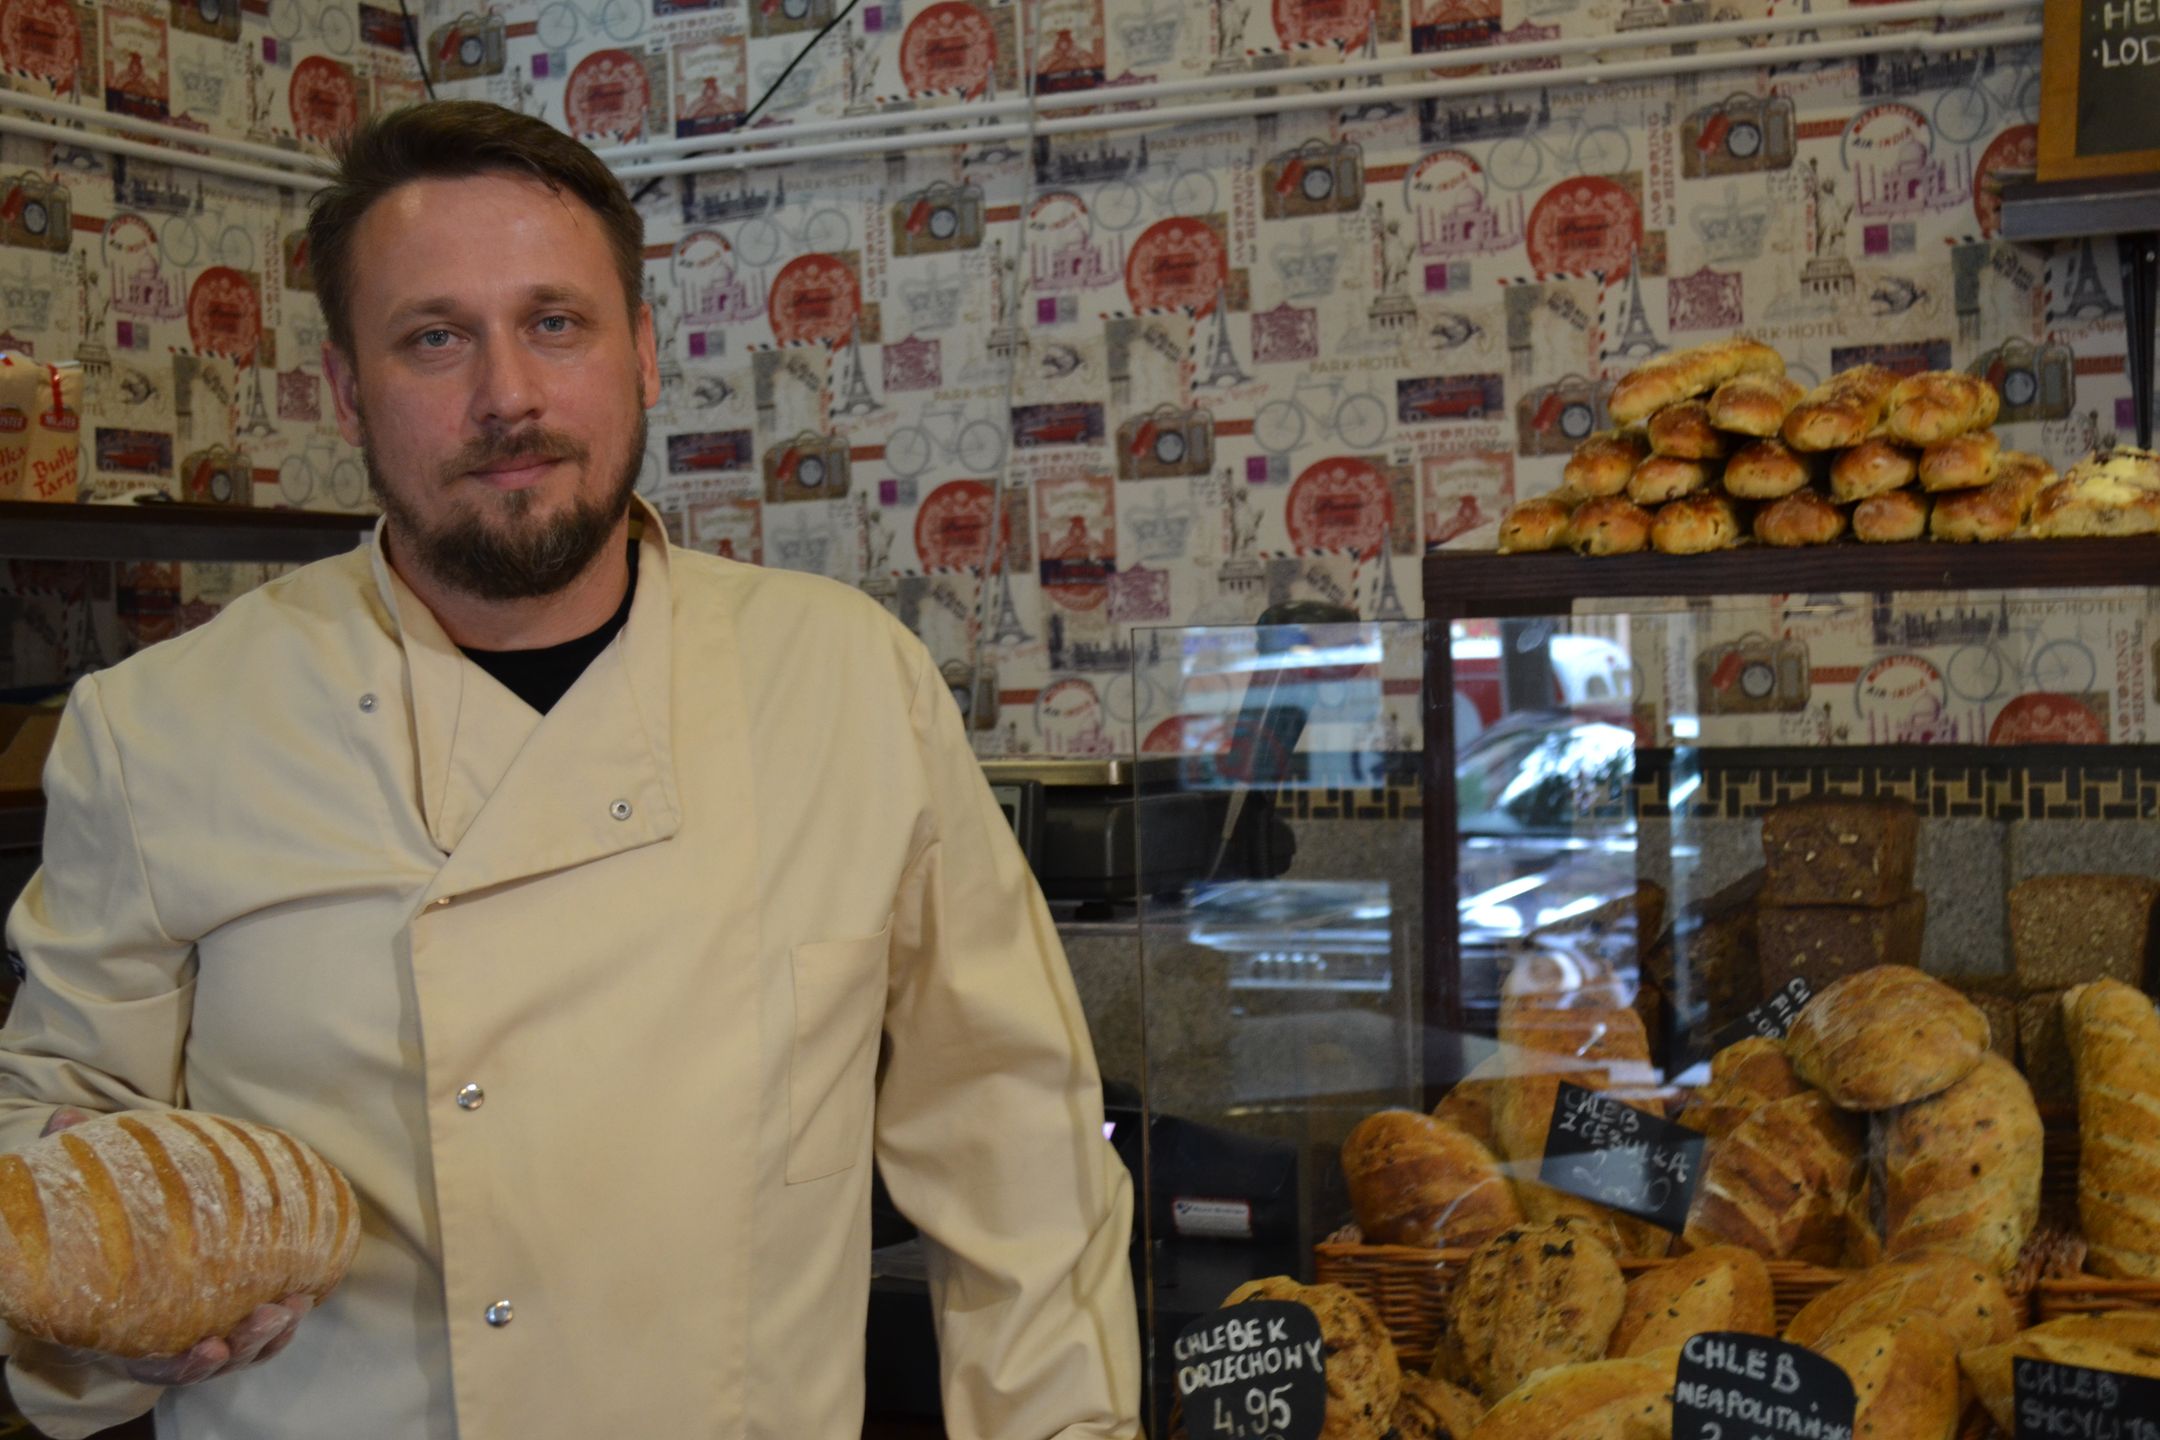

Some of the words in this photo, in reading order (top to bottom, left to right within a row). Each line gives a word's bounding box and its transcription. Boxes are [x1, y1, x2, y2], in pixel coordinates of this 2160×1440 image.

[2103, 0, 2160, 31] HE
[1566, 1089, 1640, 1133] CHLEB
[1174, 1316, 1289, 1361] CHLEBEK
[1178, 1336, 1324, 1396] ORZECHOWY
[1683, 1335, 1801, 1394] CHLEB
[2017, 1360, 2119, 1409] CHLEB
